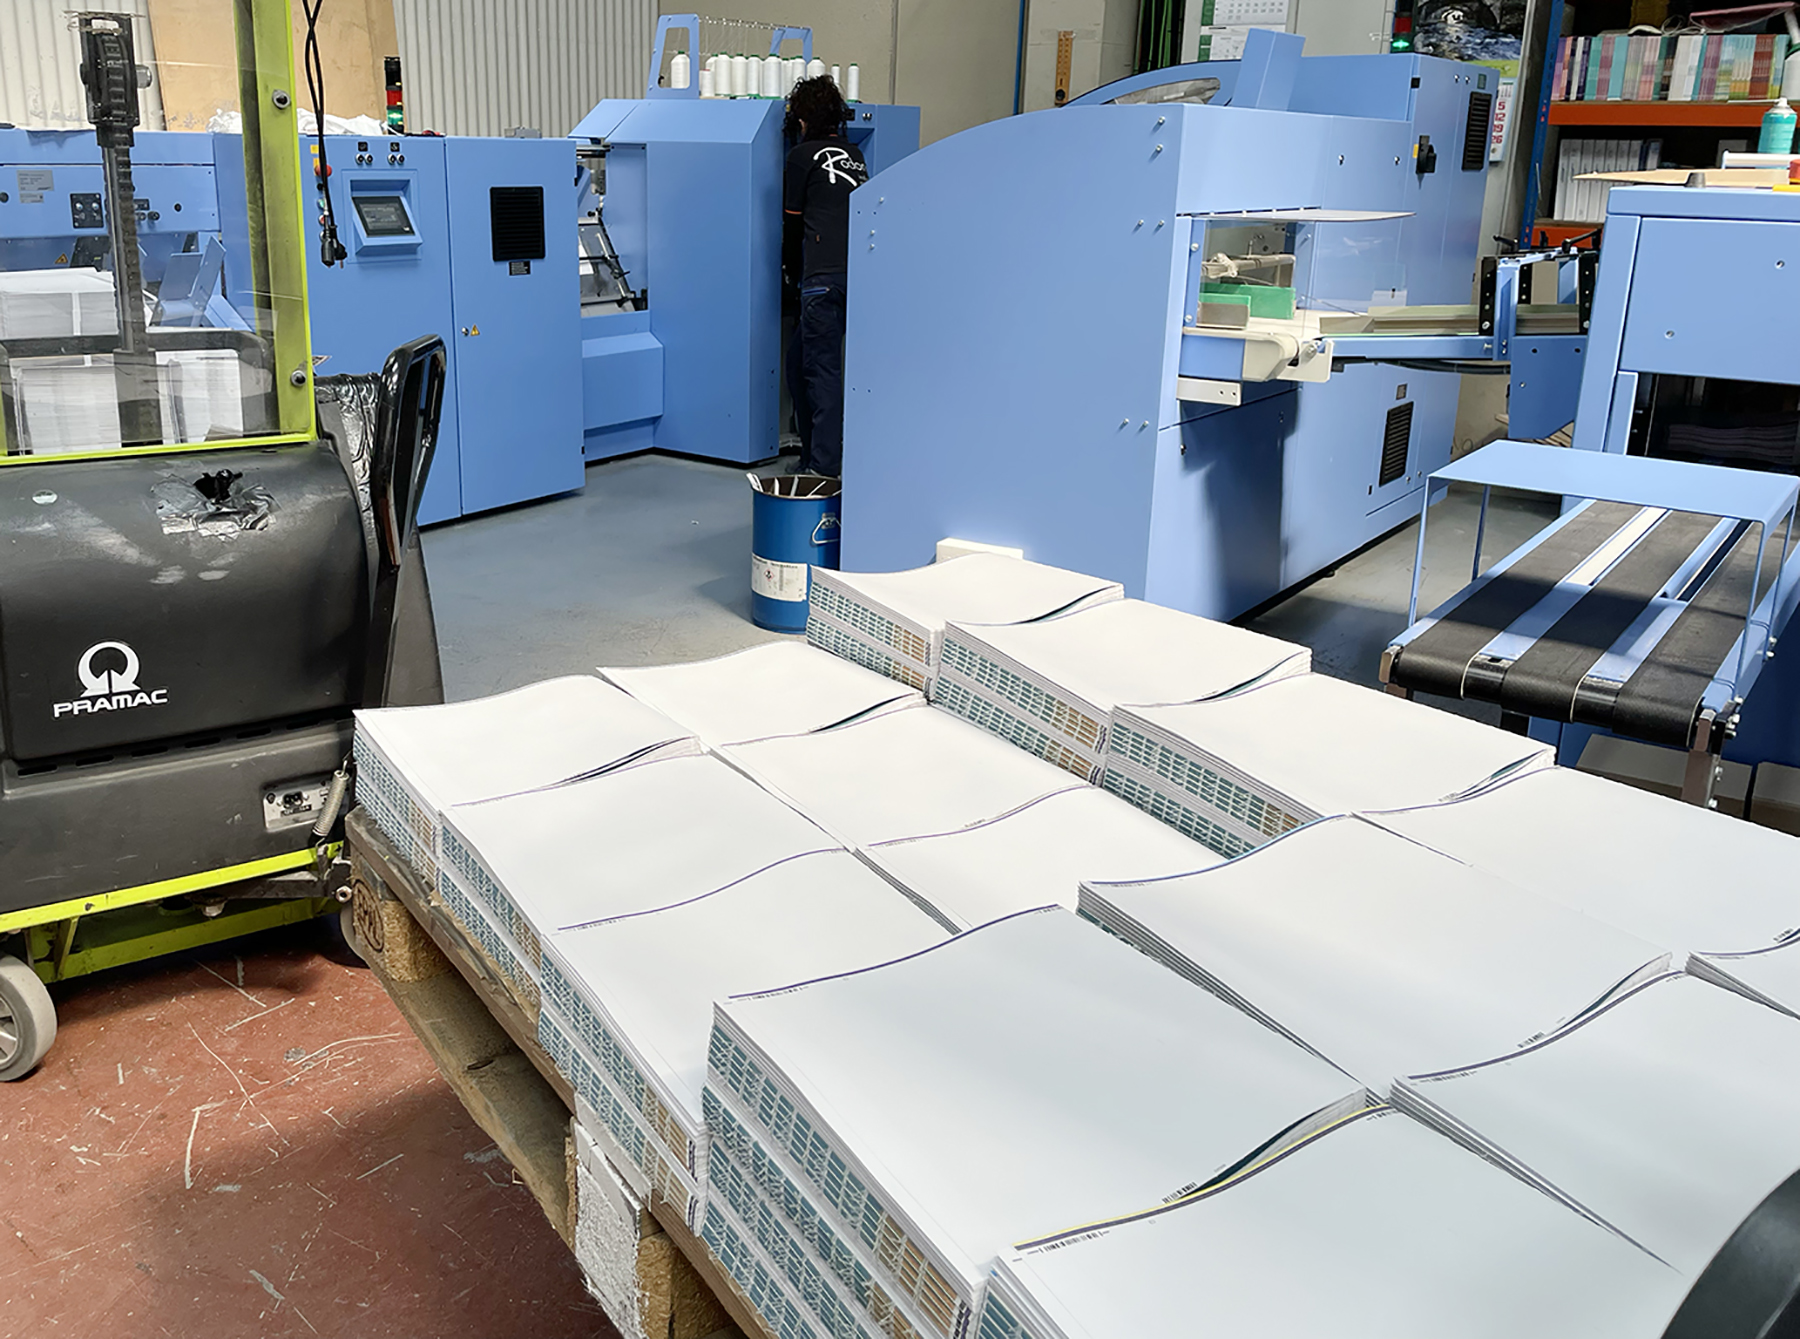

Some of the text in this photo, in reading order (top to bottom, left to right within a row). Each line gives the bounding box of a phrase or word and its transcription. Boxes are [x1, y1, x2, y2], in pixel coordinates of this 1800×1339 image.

[1498, 101, 1506, 110] 5
[1494, 113, 1506, 122] 12
[1491, 135, 1503, 144] 26
[53, 688, 168, 718] PRAMAC
